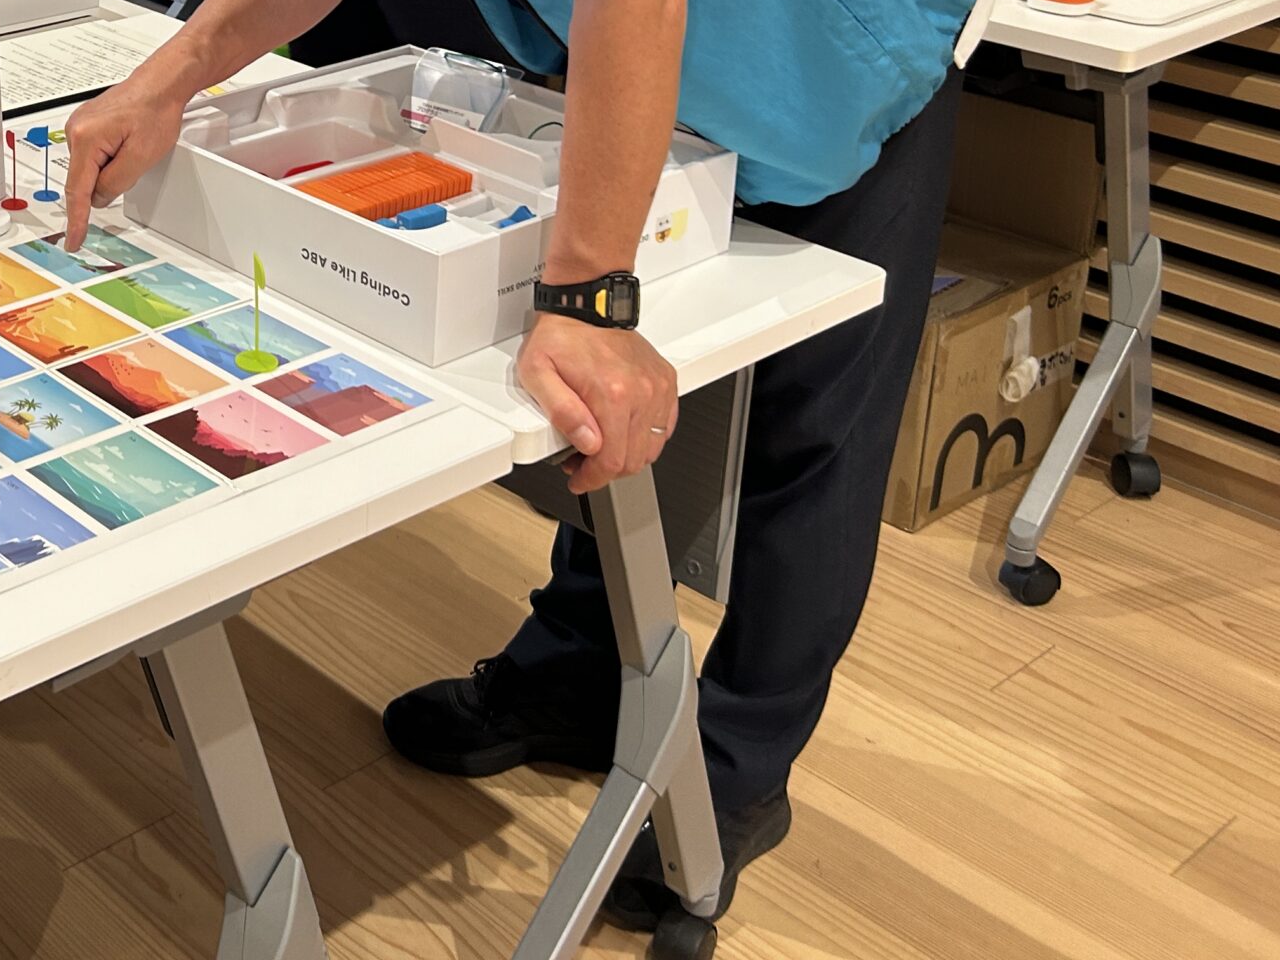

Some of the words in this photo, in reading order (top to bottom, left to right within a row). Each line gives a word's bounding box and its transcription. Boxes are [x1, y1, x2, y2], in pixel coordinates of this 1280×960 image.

[301, 247, 327, 268] ABC
[330, 261, 357, 283] Like
[360, 271, 411, 306] Coding
[497, 284, 515, 296] SKILL
